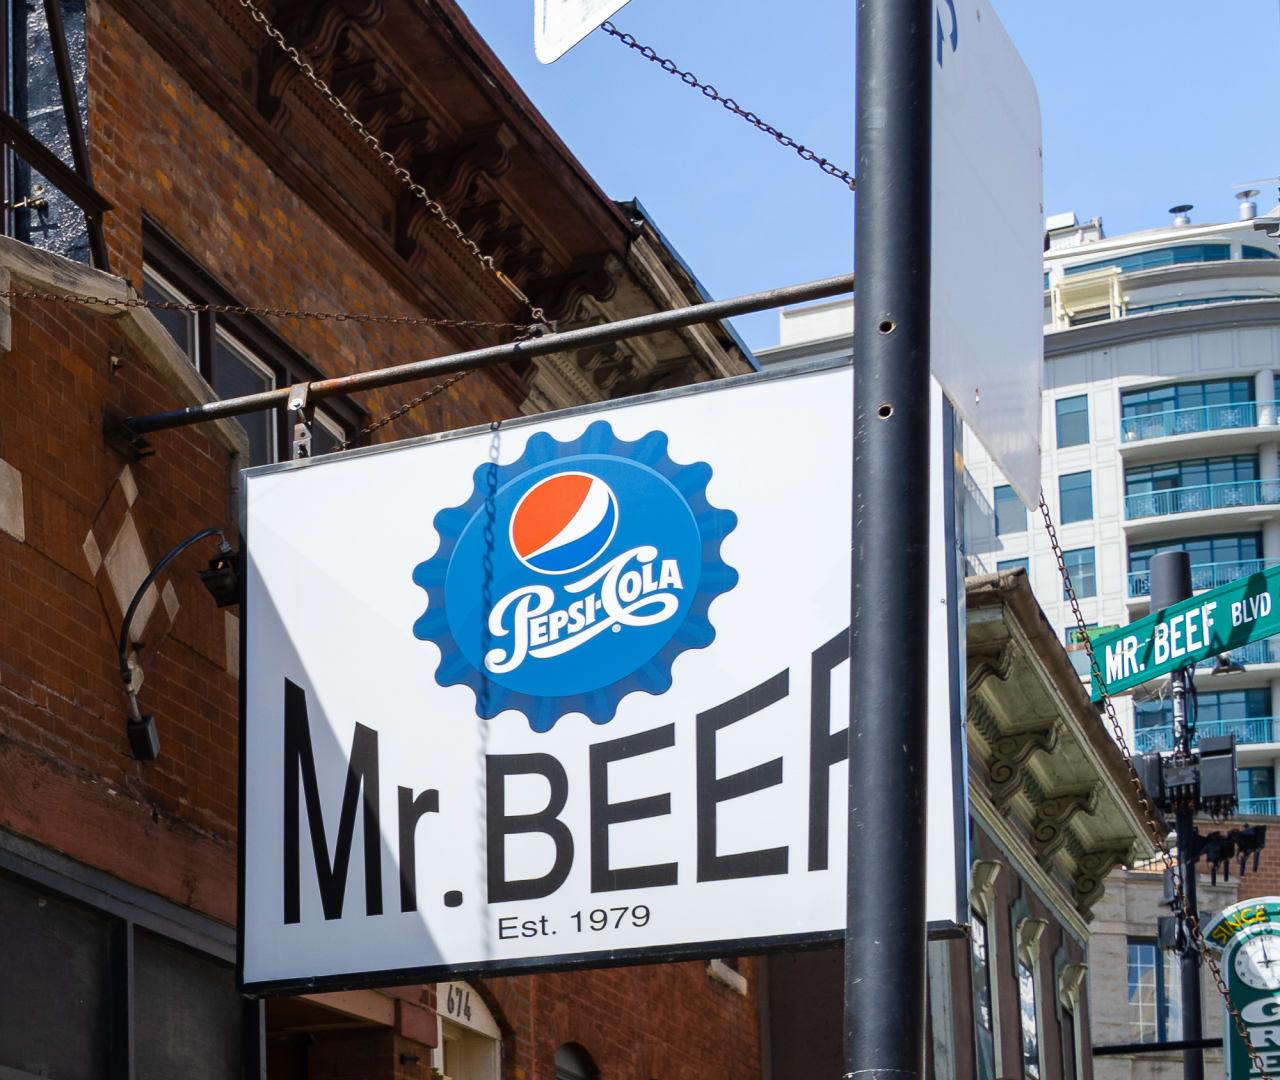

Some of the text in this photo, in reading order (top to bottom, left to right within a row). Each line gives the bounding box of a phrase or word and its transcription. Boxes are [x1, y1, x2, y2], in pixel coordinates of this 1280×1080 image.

[1106, 591, 1272, 684] MR. BEEF BLVD
[284, 677, 464, 925] Mr.
[497, 904, 652, 940] Est. 1979
[1211, 905, 1267, 944] SINCE
[447, 984, 471, 1022] 674
